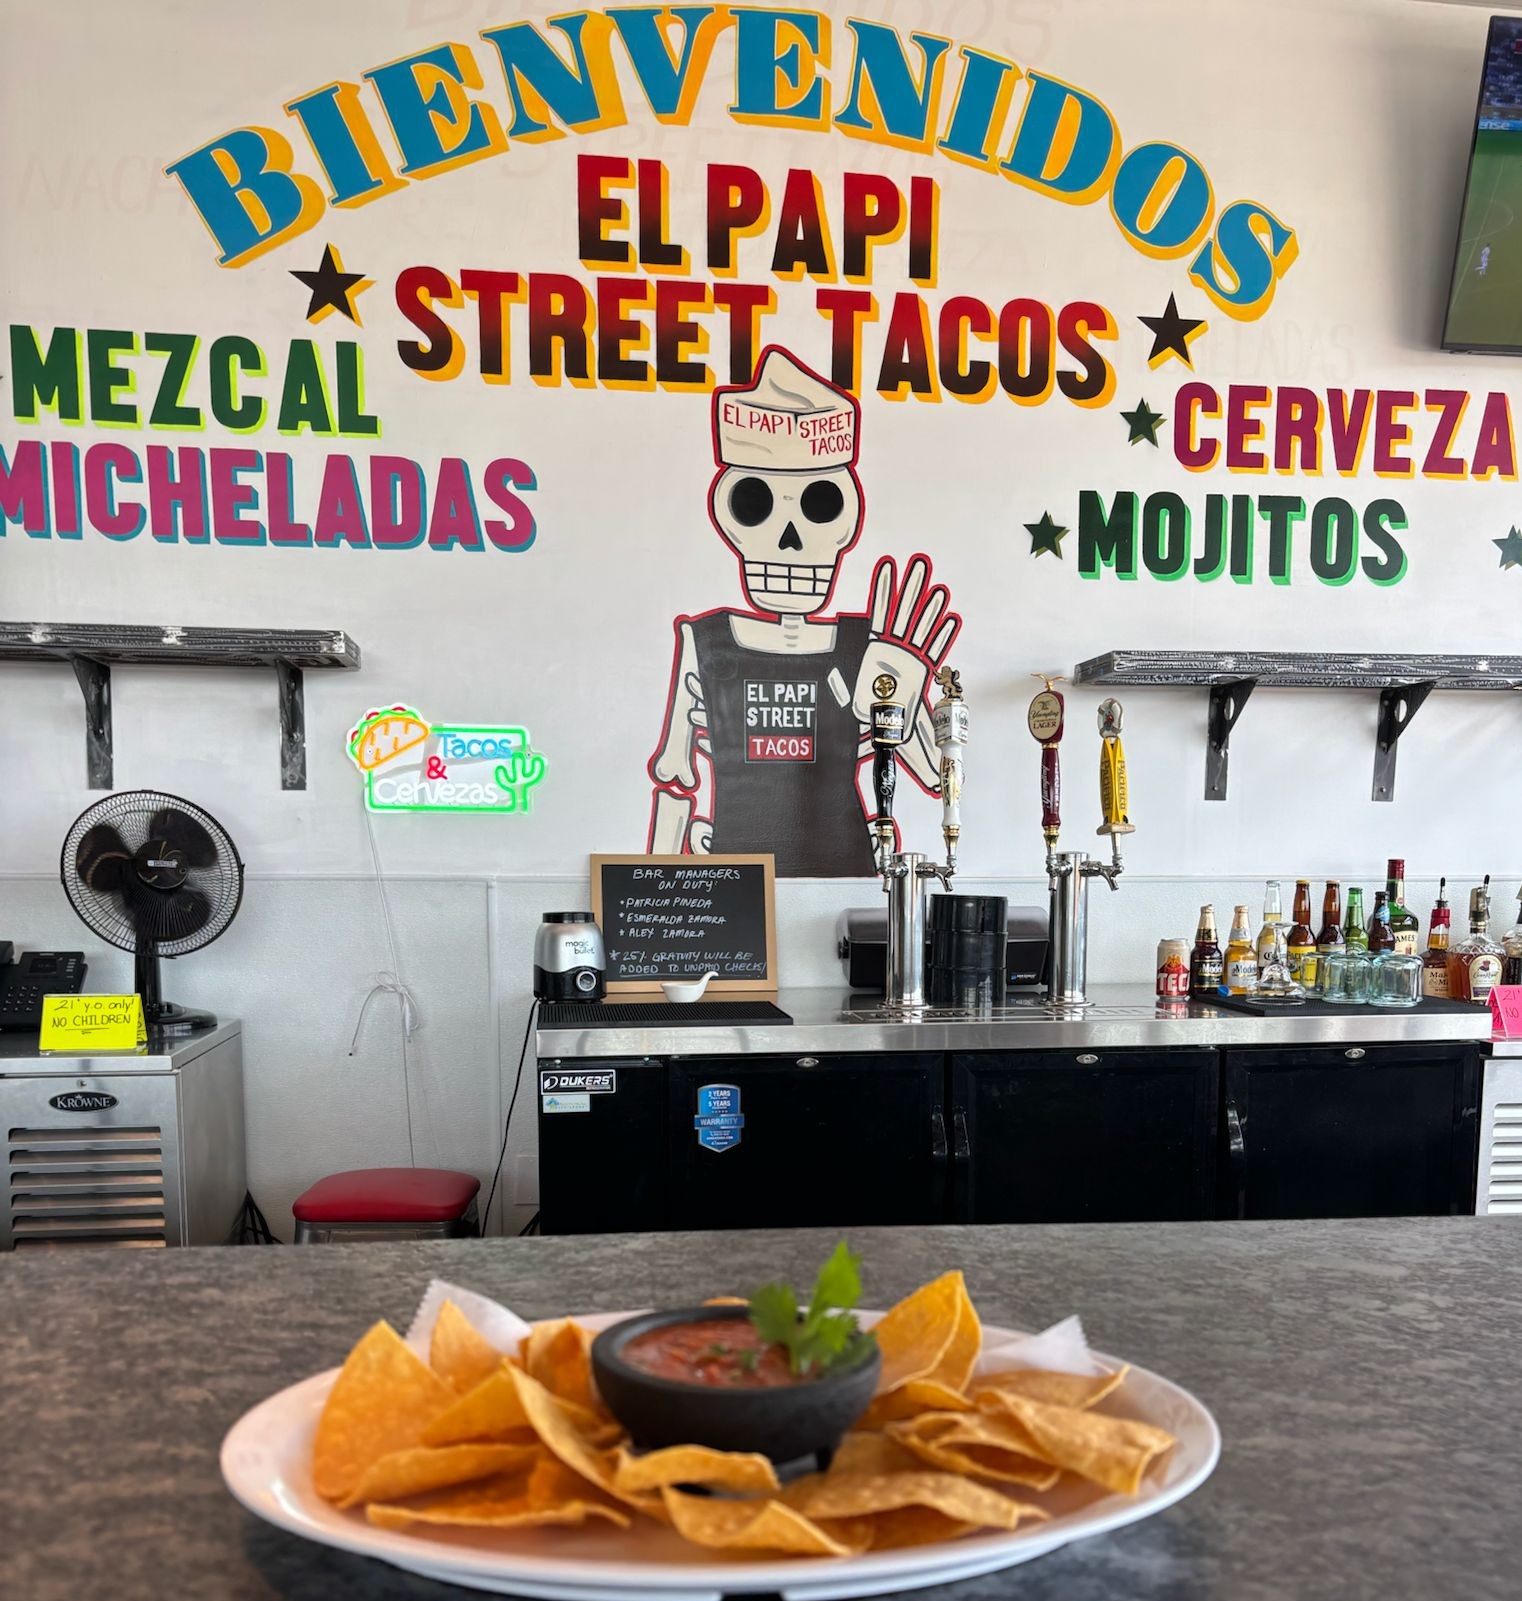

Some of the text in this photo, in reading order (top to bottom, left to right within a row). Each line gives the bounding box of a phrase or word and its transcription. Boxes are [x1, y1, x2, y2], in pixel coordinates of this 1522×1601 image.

[165, 3, 1299, 323] BIENVENIDOS
[577, 153, 691, 276] EL
[706, 163, 942, 289] PAPI
[396, 266, 778, 393] STREET
[815, 289, 1120, 410] TACOS
[9, 324, 383, 440] MEZCAL
[723, 402, 853, 439] EL PAPI STREET
[1173, 382, 1519, 481] CERVEZA
[809, 433, 852, 456] TACOS
[0, 440, 536, 552] MICHELADAS
[1078, 490, 1408, 586] MOJITOS
[747, 683, 816, 704] EL PAPI
[746, 706, 816, 728] STREET
[436, 732, 513, 760] Tacos
[752, 738, 810, 757] TACOS
[426, 755, 448, 780] &
[373, 778, 499, 805] Cervezas
[632, 868, 741, 880] BAR MANAGERS
[658, 880, 677, 890] ON
[625, 897, 713, 908] PATRICIA PINEDA
[626, 912, 727, 925] ESMERALDA ZAMORA
[662, 928, 706, 939] ZAMORA
[703, 951, 732, 960] WILL
[734, 950, 754, 961] BE
[619, 963, 659, 974] ADDED
[667, 963, 680, 973] TO
[1157, 972, 1190, 992] TEC
[52, 1013, 131, 1028] NO CHILDREN
[560, 1075, 611, 1086] DUKERS
[56, 1095, 112, 1108] KROWNE
[712, 1089, 731, 1097] YEARS
[700, 1118, 738, 1126] WARRANTY
